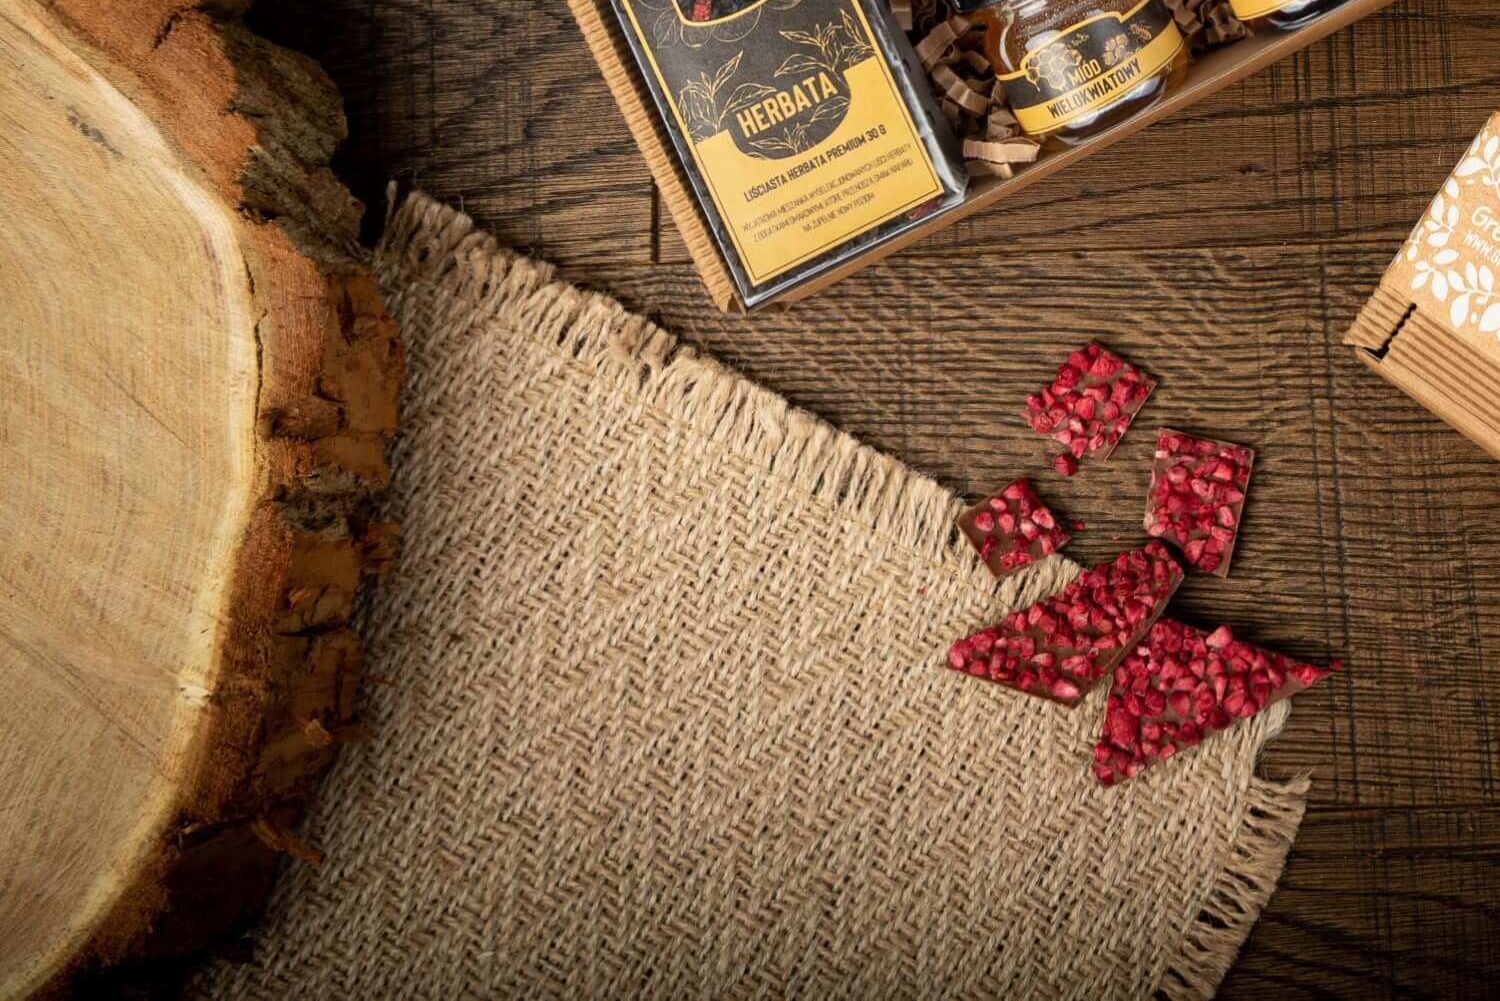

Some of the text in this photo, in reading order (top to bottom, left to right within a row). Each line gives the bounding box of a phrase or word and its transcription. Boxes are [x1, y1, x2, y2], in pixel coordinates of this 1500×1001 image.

[735, 69, 838, 139] HERBATA
[1046, 58, 1143, 121] WIELOKWIATOWY
[1066, 55, 1103, 87] MIÓD
[743, 123, 886, 202] LIŚCIASTA HERBATA PREMIUM 30 G
